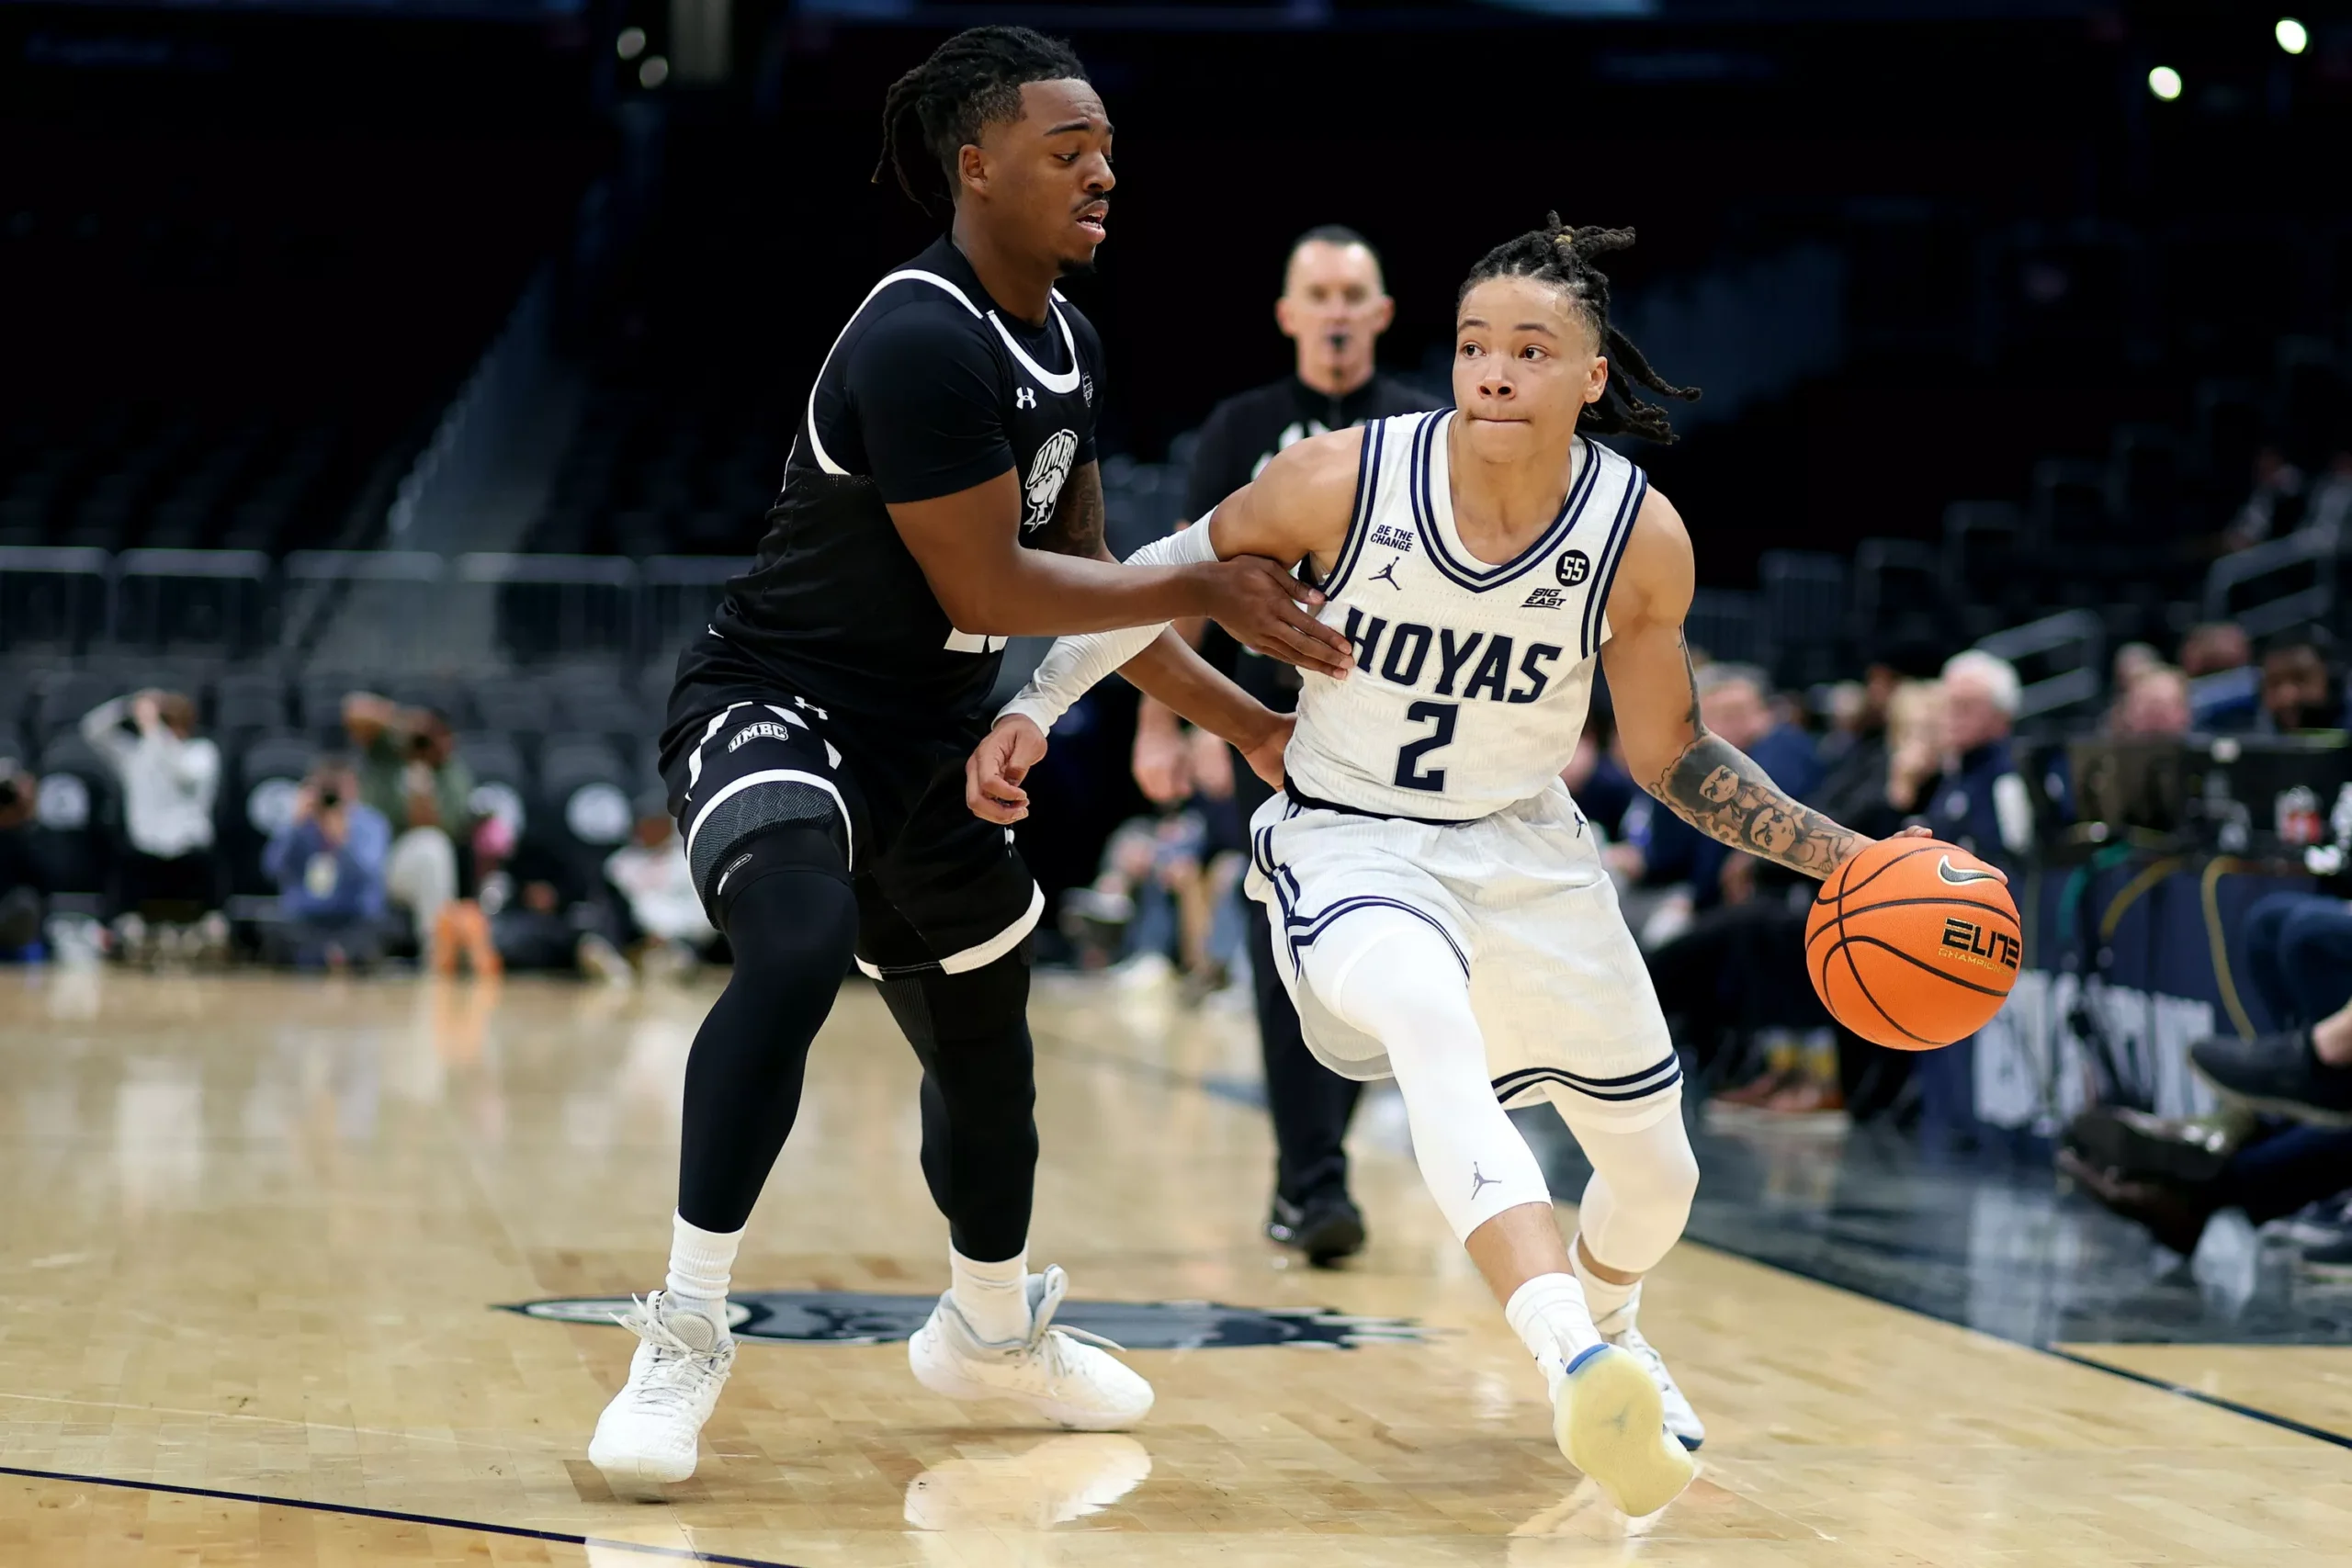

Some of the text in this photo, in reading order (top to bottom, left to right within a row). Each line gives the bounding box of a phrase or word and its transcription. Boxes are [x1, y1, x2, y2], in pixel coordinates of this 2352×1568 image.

[1370, 533, 1413, 552] CHANGE
[1376, 525, 1414, 542] BE THE
[1561, 556, 1586, 581] 55
[1525, 596, 1566, 606] EAST
[1532, 588, 1562, 597] BIG
[1344, 605, 1564, 704] HOYAS
[728, 720, 788, 753] UMBC
[1392, 699, 1461, 794] 2
[1941, 918, 2020, 971] ELITE
